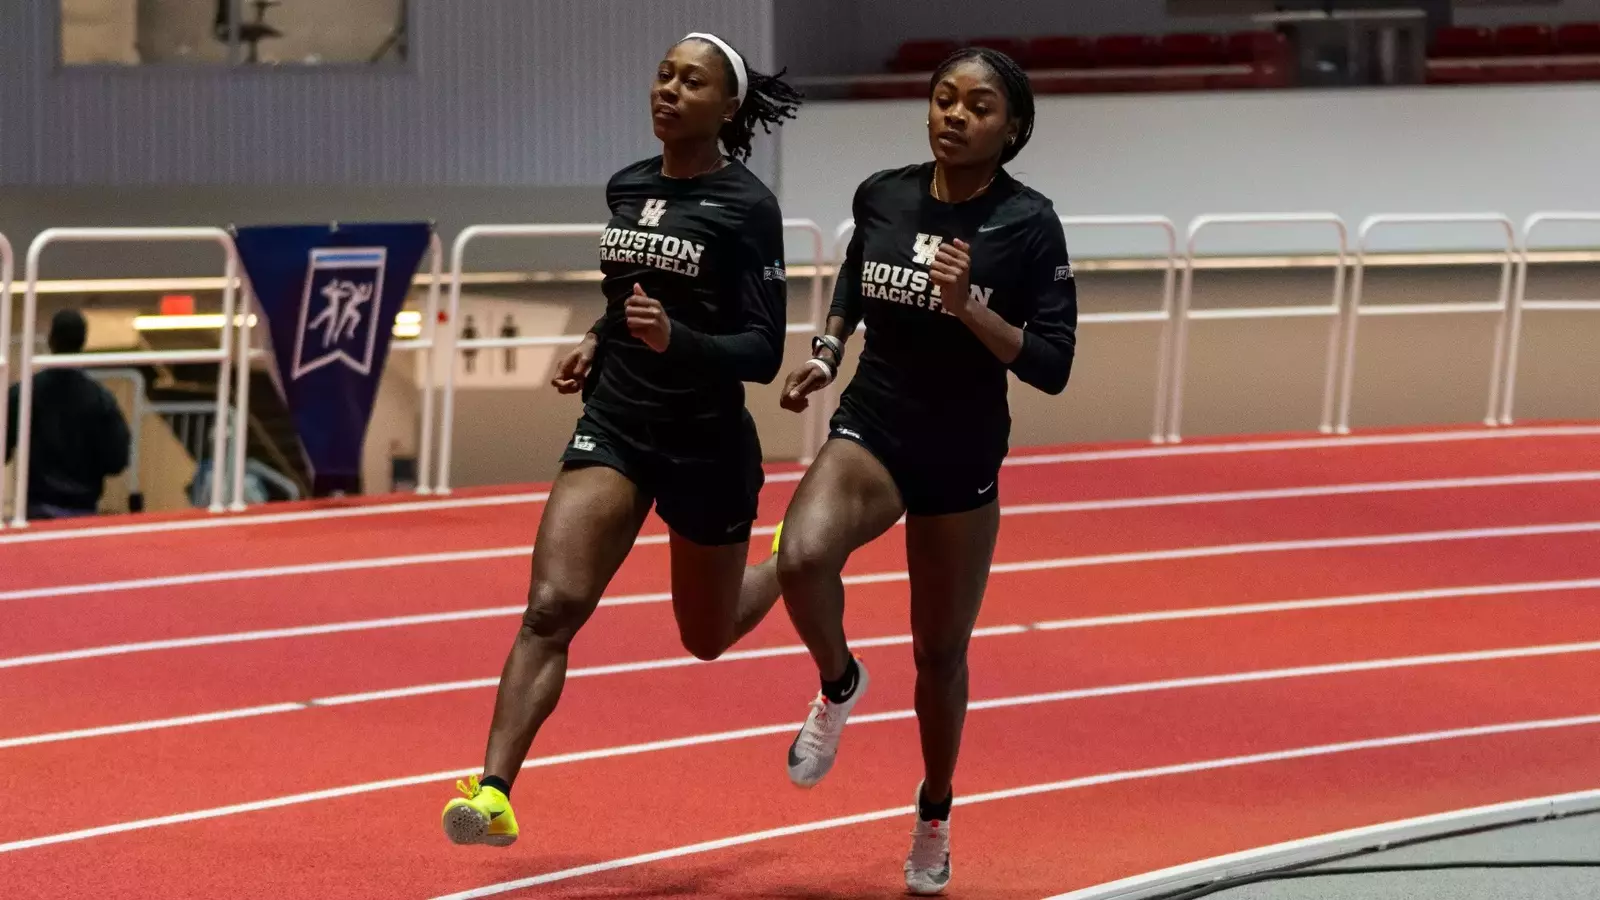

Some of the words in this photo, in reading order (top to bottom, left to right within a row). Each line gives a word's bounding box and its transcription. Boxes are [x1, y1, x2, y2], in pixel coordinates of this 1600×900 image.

[600, 227, 704, 263] HOUSTON
[599, 247, 636, 263] RACK
[646, 253, 700, 278] FIELD
[861, 282, 913, 305] TRACK
